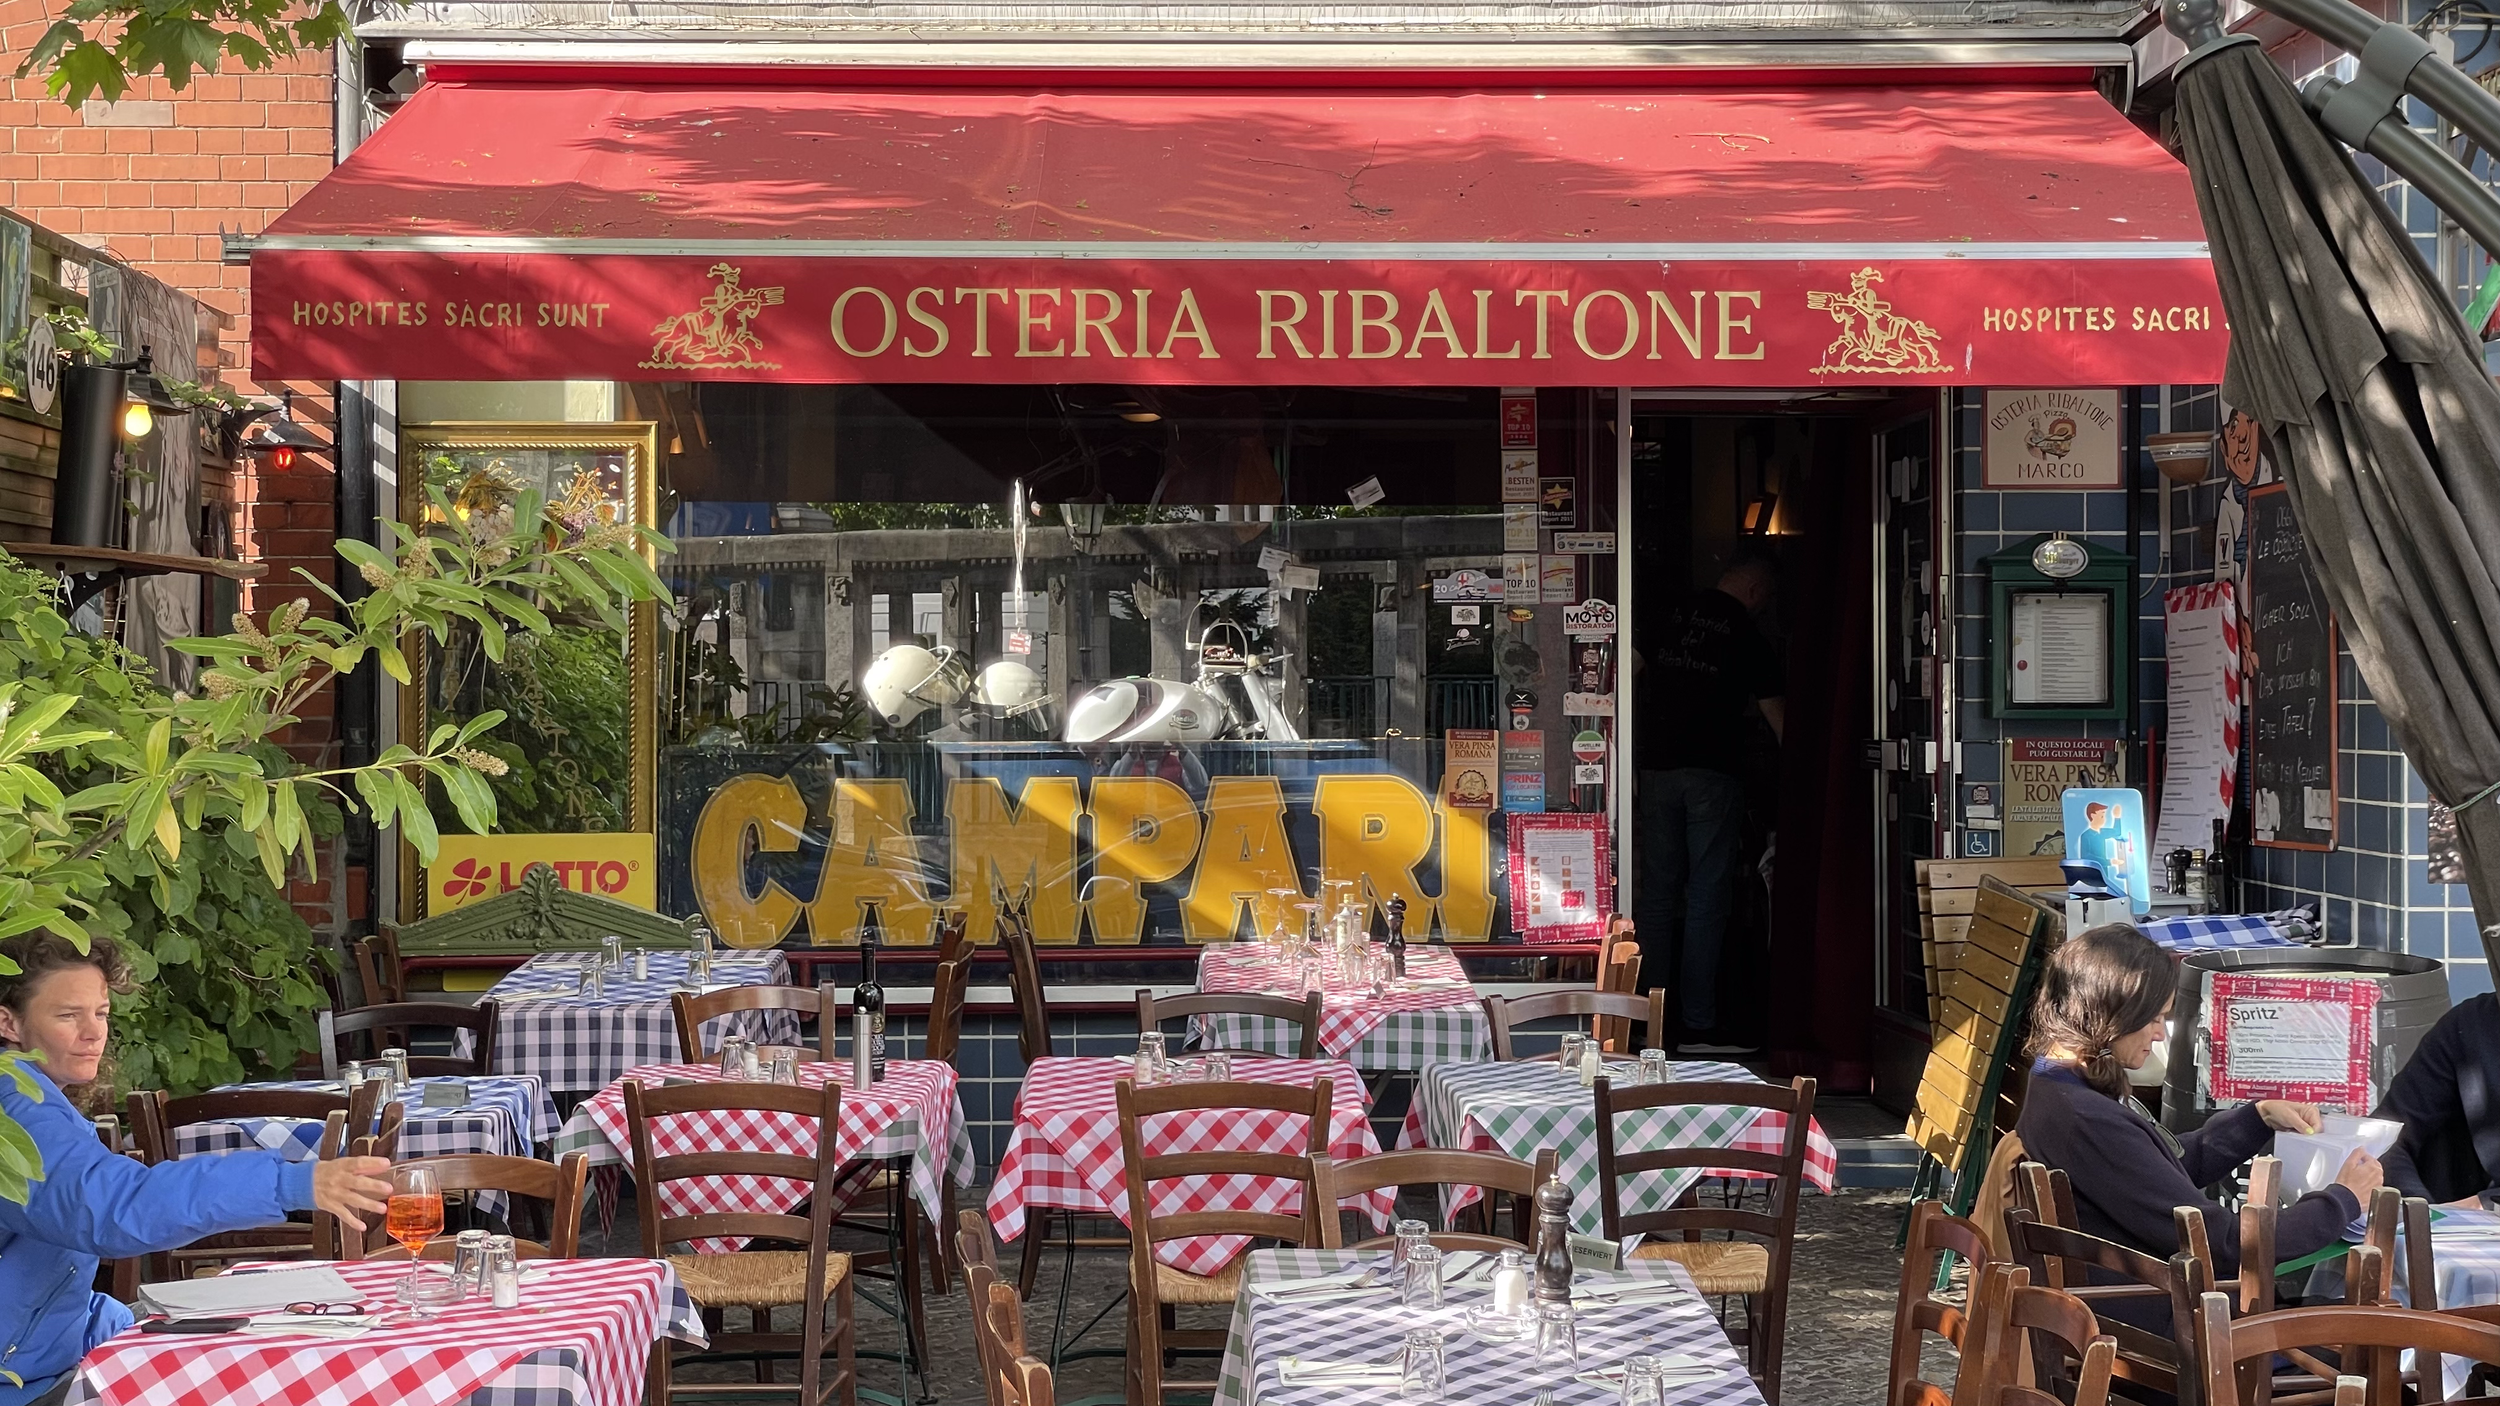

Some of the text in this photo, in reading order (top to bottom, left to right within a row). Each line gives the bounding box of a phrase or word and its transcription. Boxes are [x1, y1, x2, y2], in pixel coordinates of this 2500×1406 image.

[293, 301, 610, 328] HOSPITES SACRI SUNT
[1983, 306, 2210, 332] HOSPITES SACRI
[830, 286, 1765, 361] OSTERIA RIBALTONE
[29, 340, 56, 392] 146
[1990, 392, 2114, 431] OSTERIA RIBALTONE
[2018, 462, 2084, 479] MARCO
[1508, 477, 1535, 485] BESTEN
[1506, 528, 1535, 538] TOP 10
[1434, 584, 1448, 594] 20
[1506, 579, 1537, 588] TOP 10
[1565, 611, 1615, 624] MOTO
[2289, 601, 2310, 622] SOLL
[1448, 741, 1496, 751] VERA PINSA
[2025, 740, 2105, 751] IN QUESTO LOCALE
[1454, 750, 1492, 758] ROMANA
[2028, 750, 2102, 758] PUOI GUSTARE LA
[1504, 774, 1542, 783] PRINZ
[2010, 764, 2121, 783] VERA PINSA
[690, 772, 1498, 949] CAMPARI
[2274, 981, 2302, 989] Abstand
[2230, 1006, 2279, 1024] Spritz
